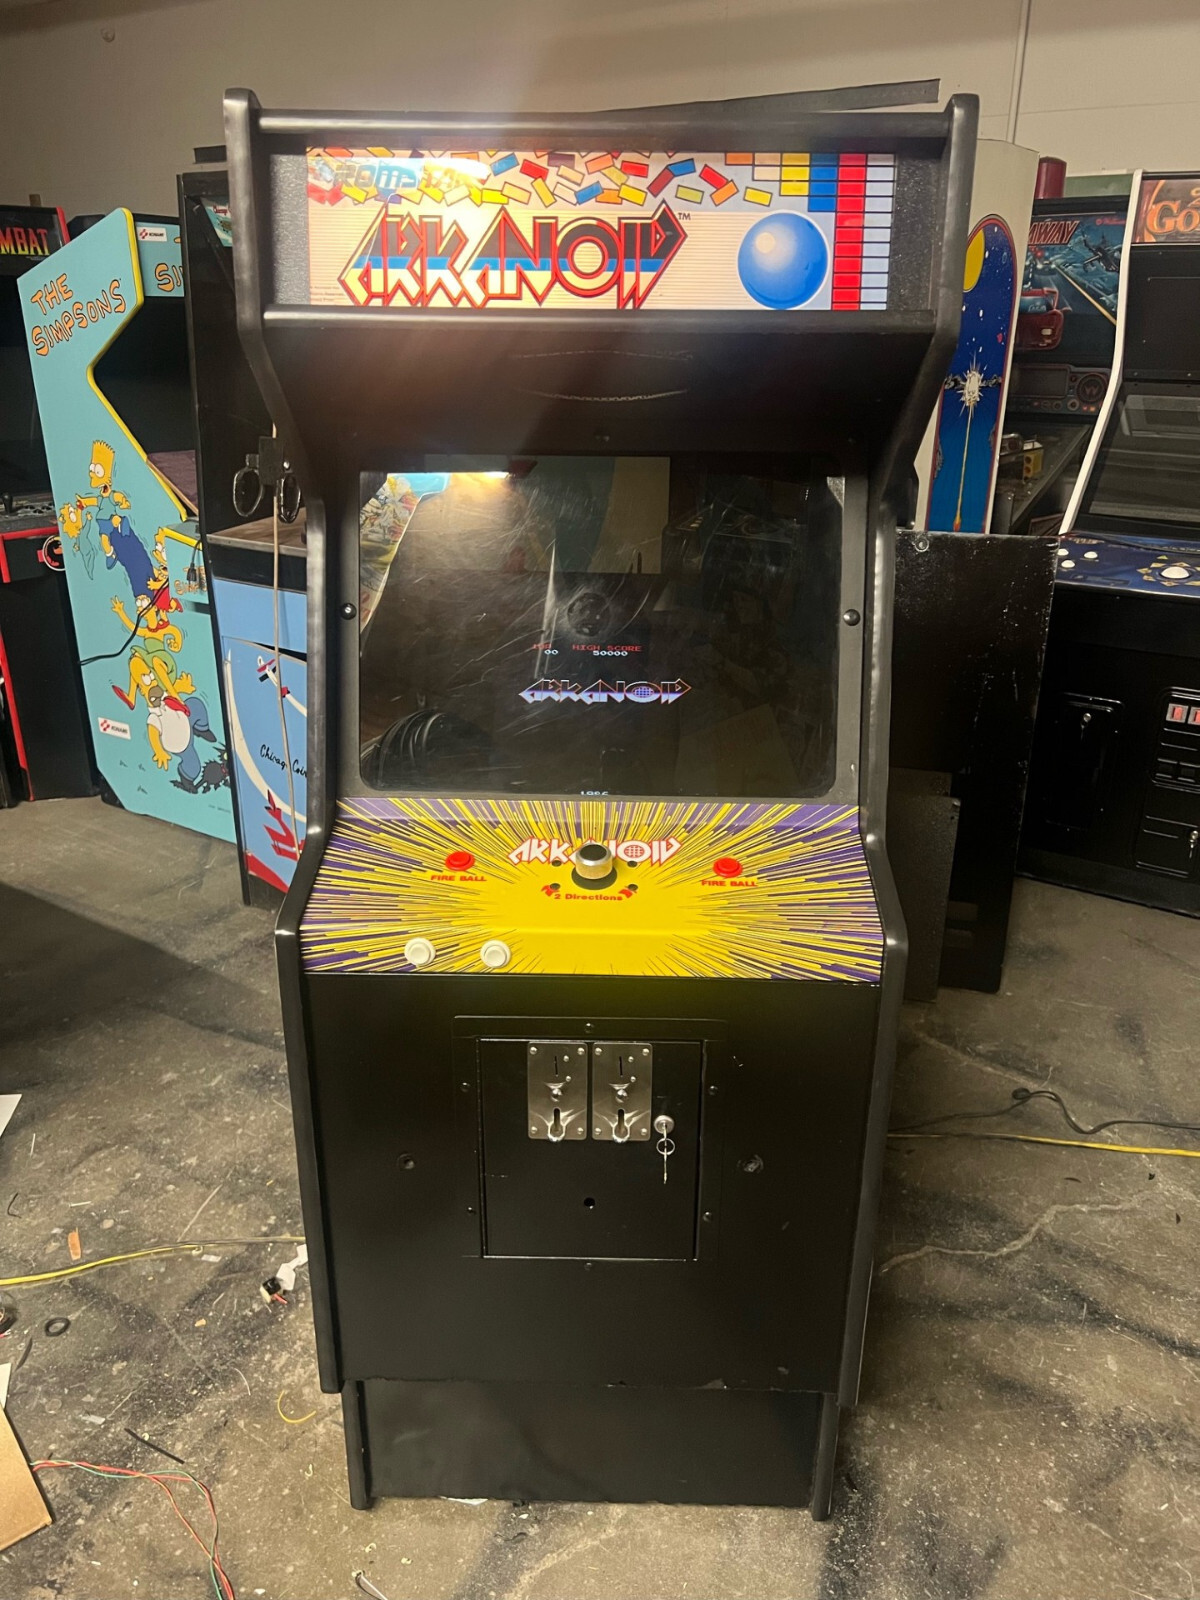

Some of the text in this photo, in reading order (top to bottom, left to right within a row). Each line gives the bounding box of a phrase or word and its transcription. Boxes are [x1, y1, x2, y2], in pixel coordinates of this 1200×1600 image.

[337, 199, 688, 310] ARKANOID
[155, 262, 183, 292] SI
[30, 273, 73, 315] THE
[31, 279, 126, 356] SIMPSONS
[518, 678, 692, 705] ARKANOID
[507, 835, 683, 867] ARKOID
[431, 874, 456, 882] FIRE
[565, 893, 623, 901] Directions
